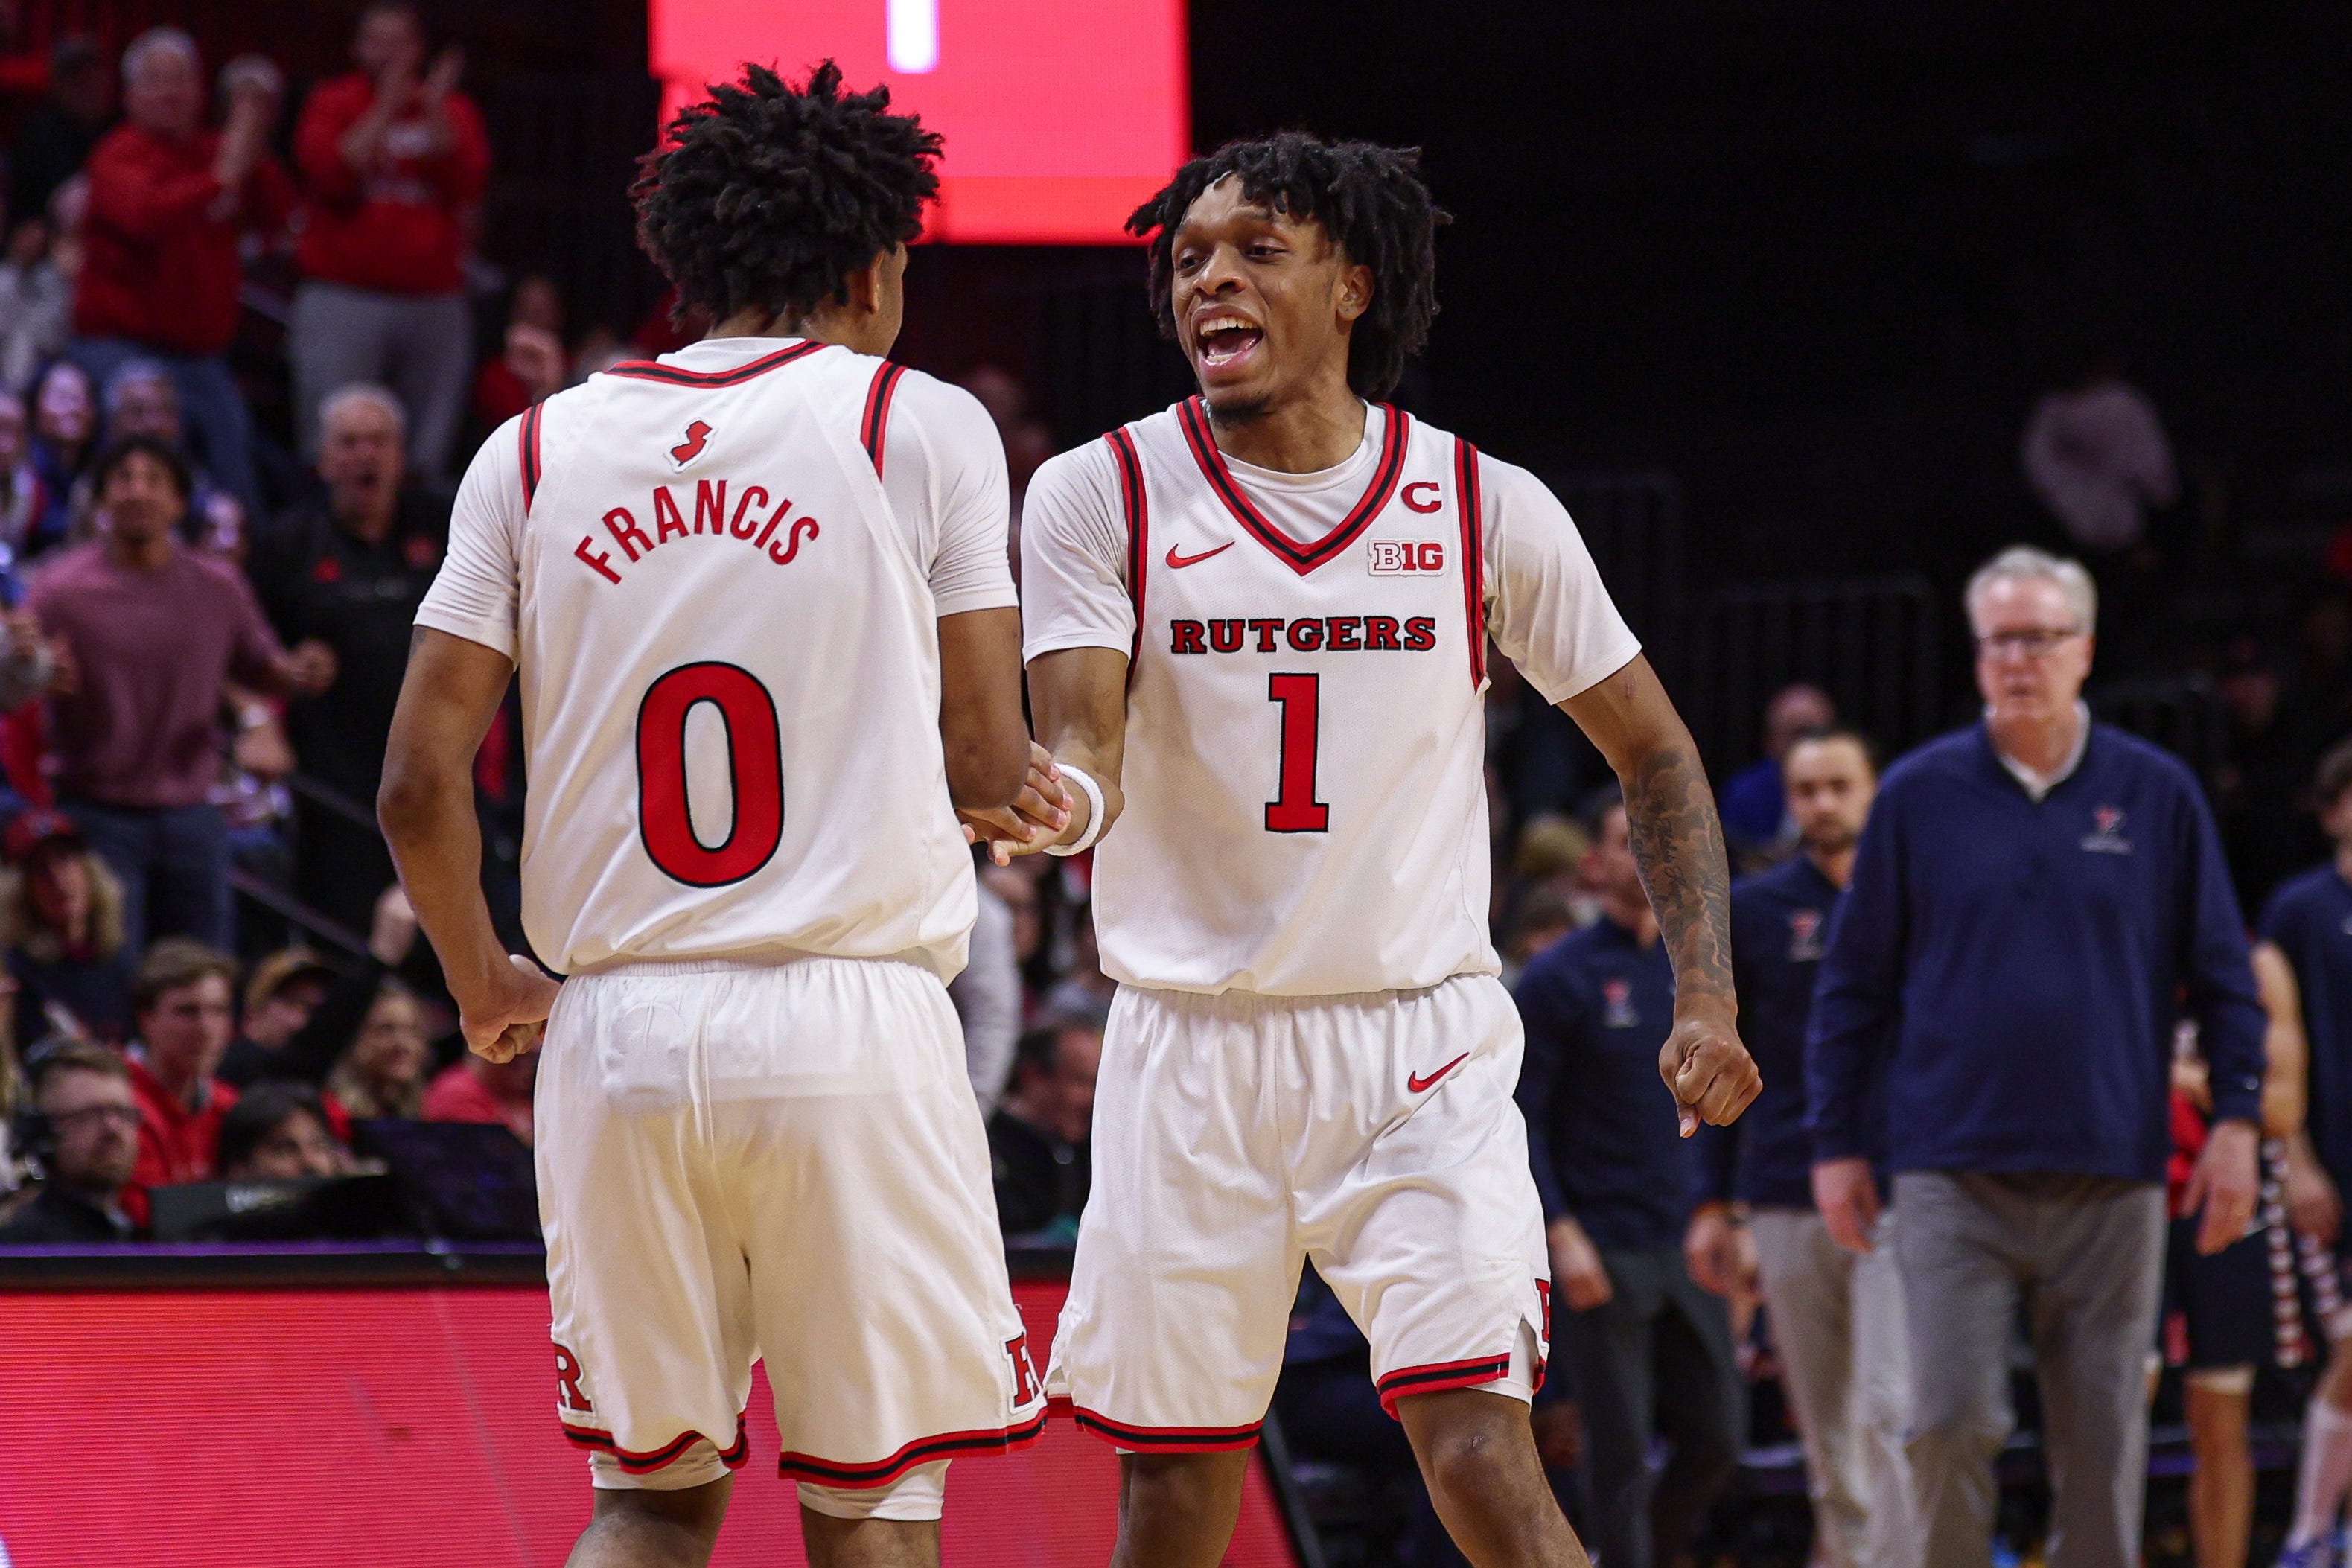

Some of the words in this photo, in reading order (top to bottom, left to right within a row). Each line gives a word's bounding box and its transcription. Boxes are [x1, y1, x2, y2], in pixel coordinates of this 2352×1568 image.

[574, 479, 820, 585] FRANCIS
[1401, 482, 1441, 514] C
[1170, 616, 1436, 654] RUTGERS
[1265, 672, 1329, 832] 1
